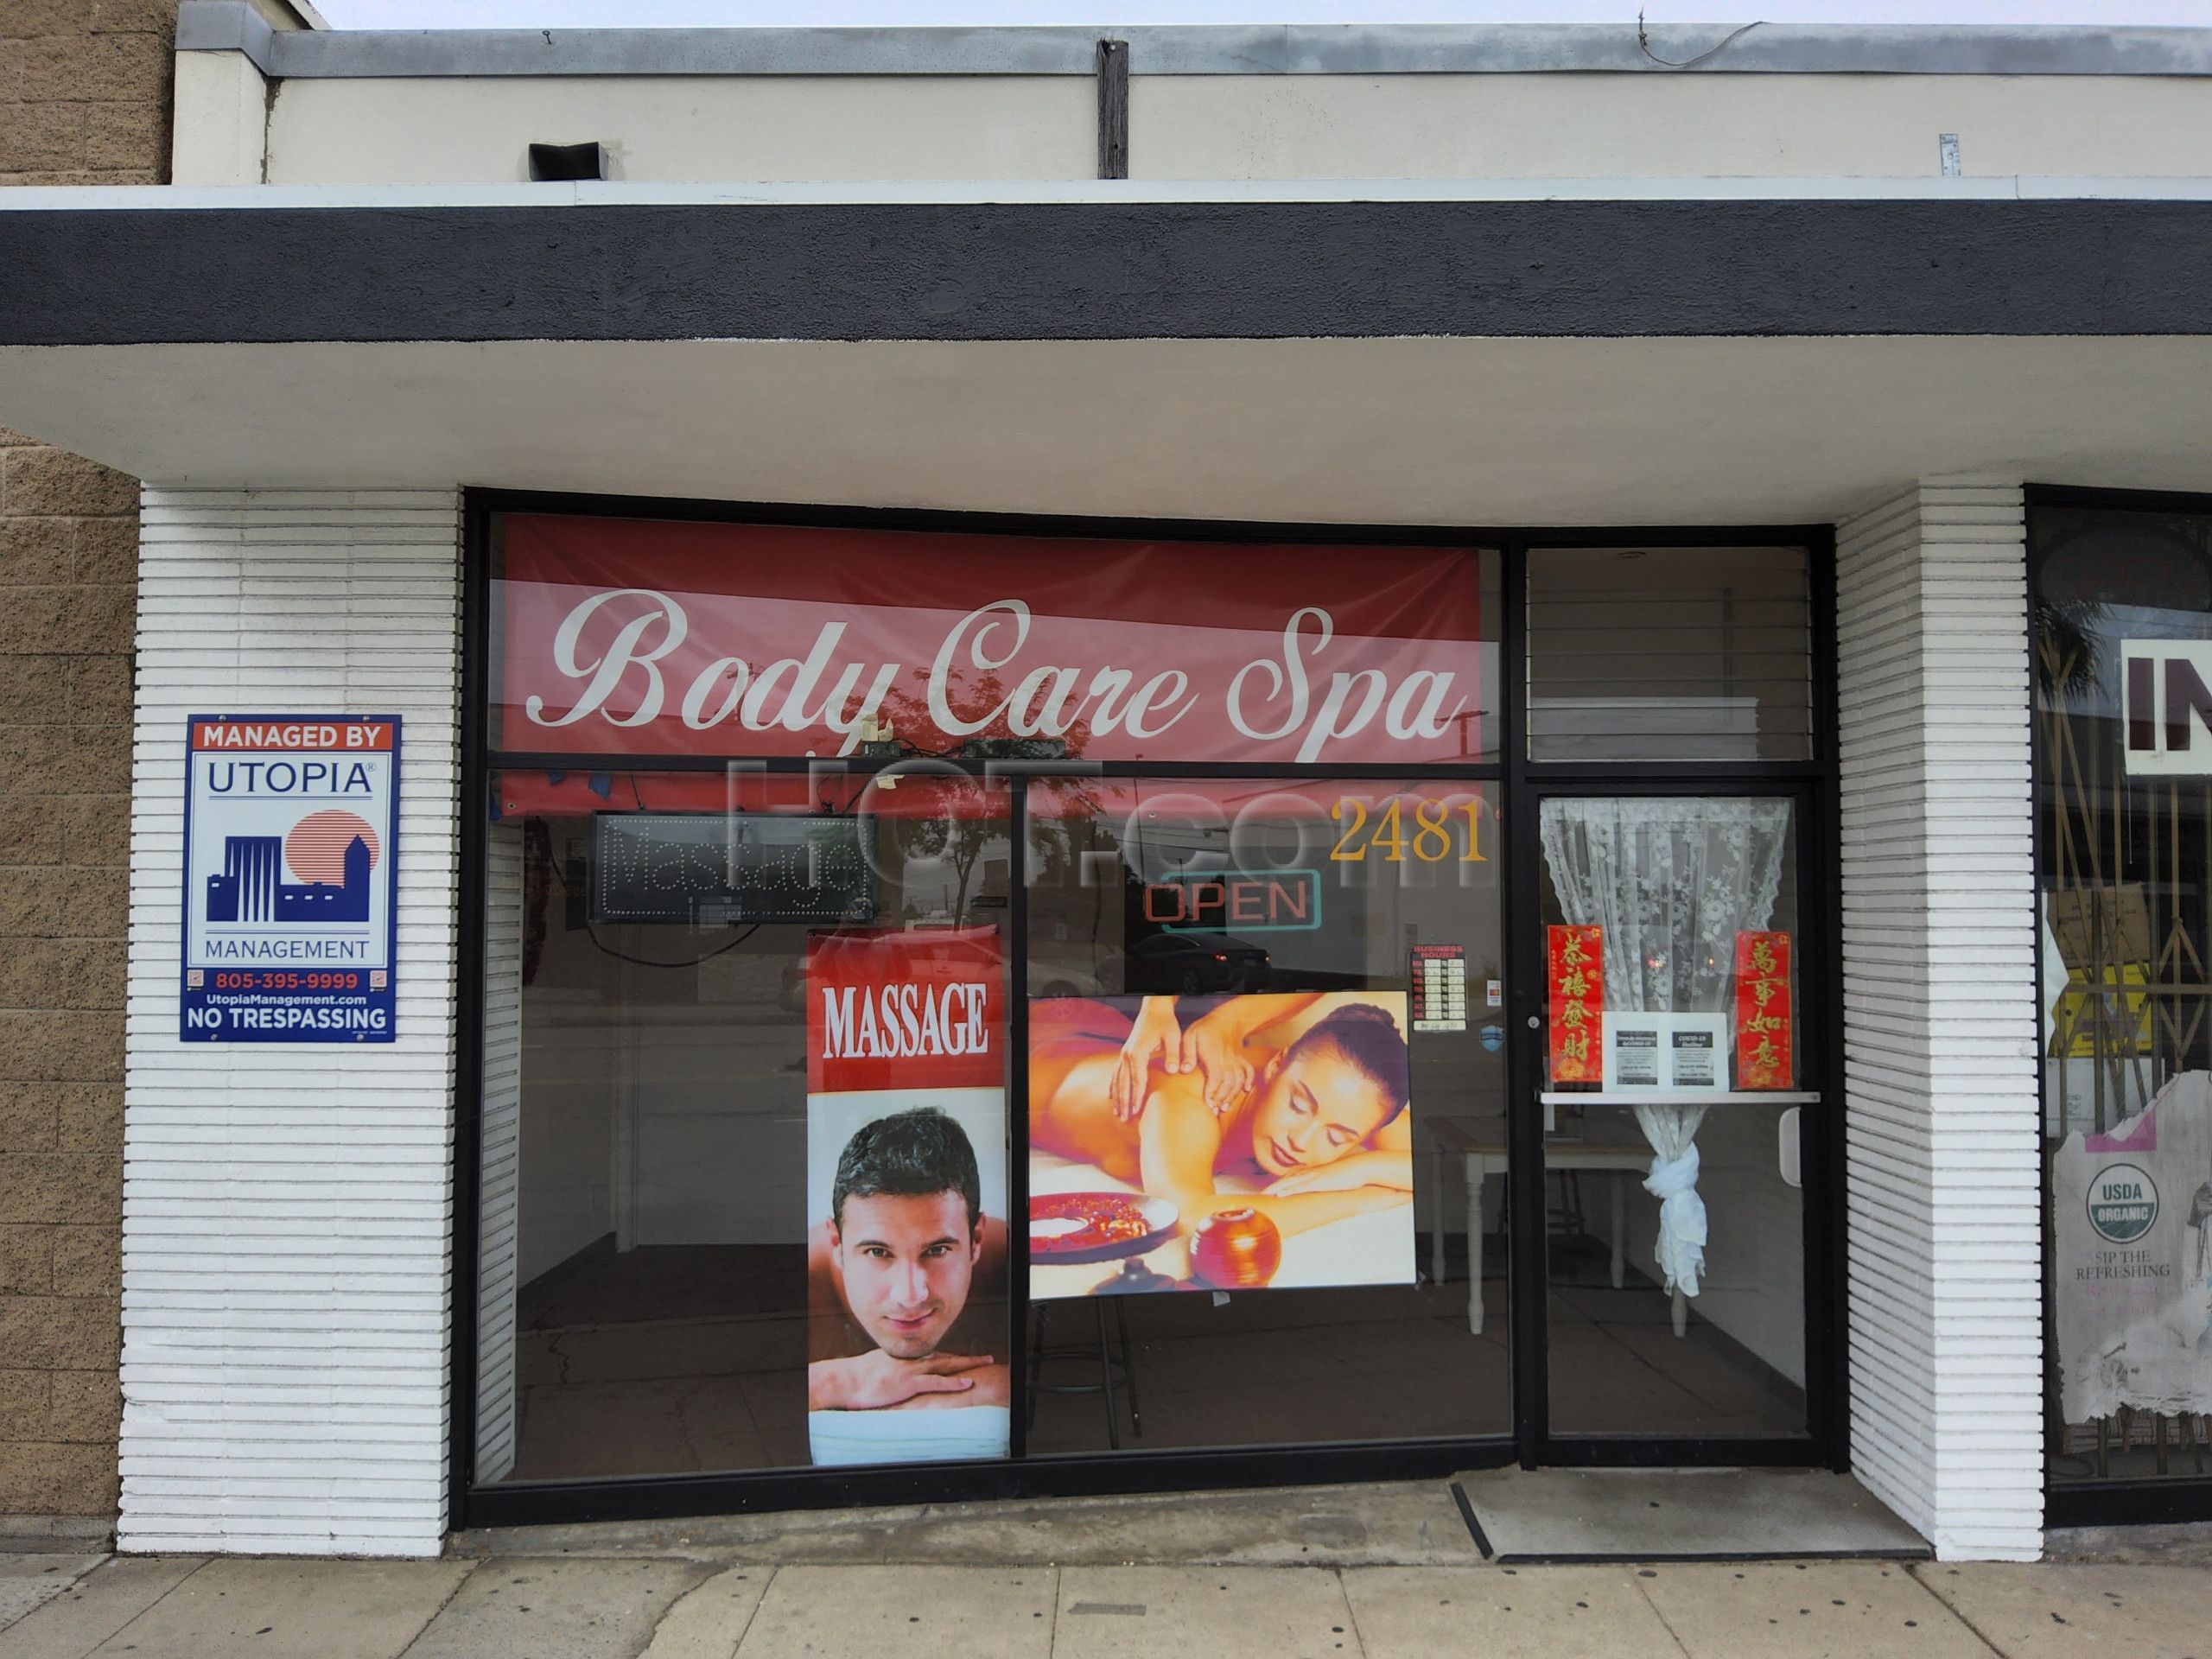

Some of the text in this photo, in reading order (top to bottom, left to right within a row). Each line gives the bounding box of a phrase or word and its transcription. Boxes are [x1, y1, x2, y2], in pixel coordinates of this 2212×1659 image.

[525, 588, 1468, 763] Body Care Spa
[202, 725, 381, 747] MANAGED BY
[1329, 797, 1490, 862] 2481
[611, 825, 859, 907] Massage
[1142, 880, 1307, 923] OPEN
[205, 939, 370, 958] MANAGEMENT
[215, 973, 358, 989] 805-395-9999
[207, 994, 367, 1006] UtopiaManagement.com
[188, 1007, 386, 1029] NO TRESPASSING
[822, 982, 988, 1058] MASSAGE
[2102, 1184, 2143, 1200] USDA
[2097, 1206, 2149, 1223] ORGANIC
[2095, 1249, 2152, 1263] SIP THE
[2076, 1263, 2171, 1280] REFRESHING
